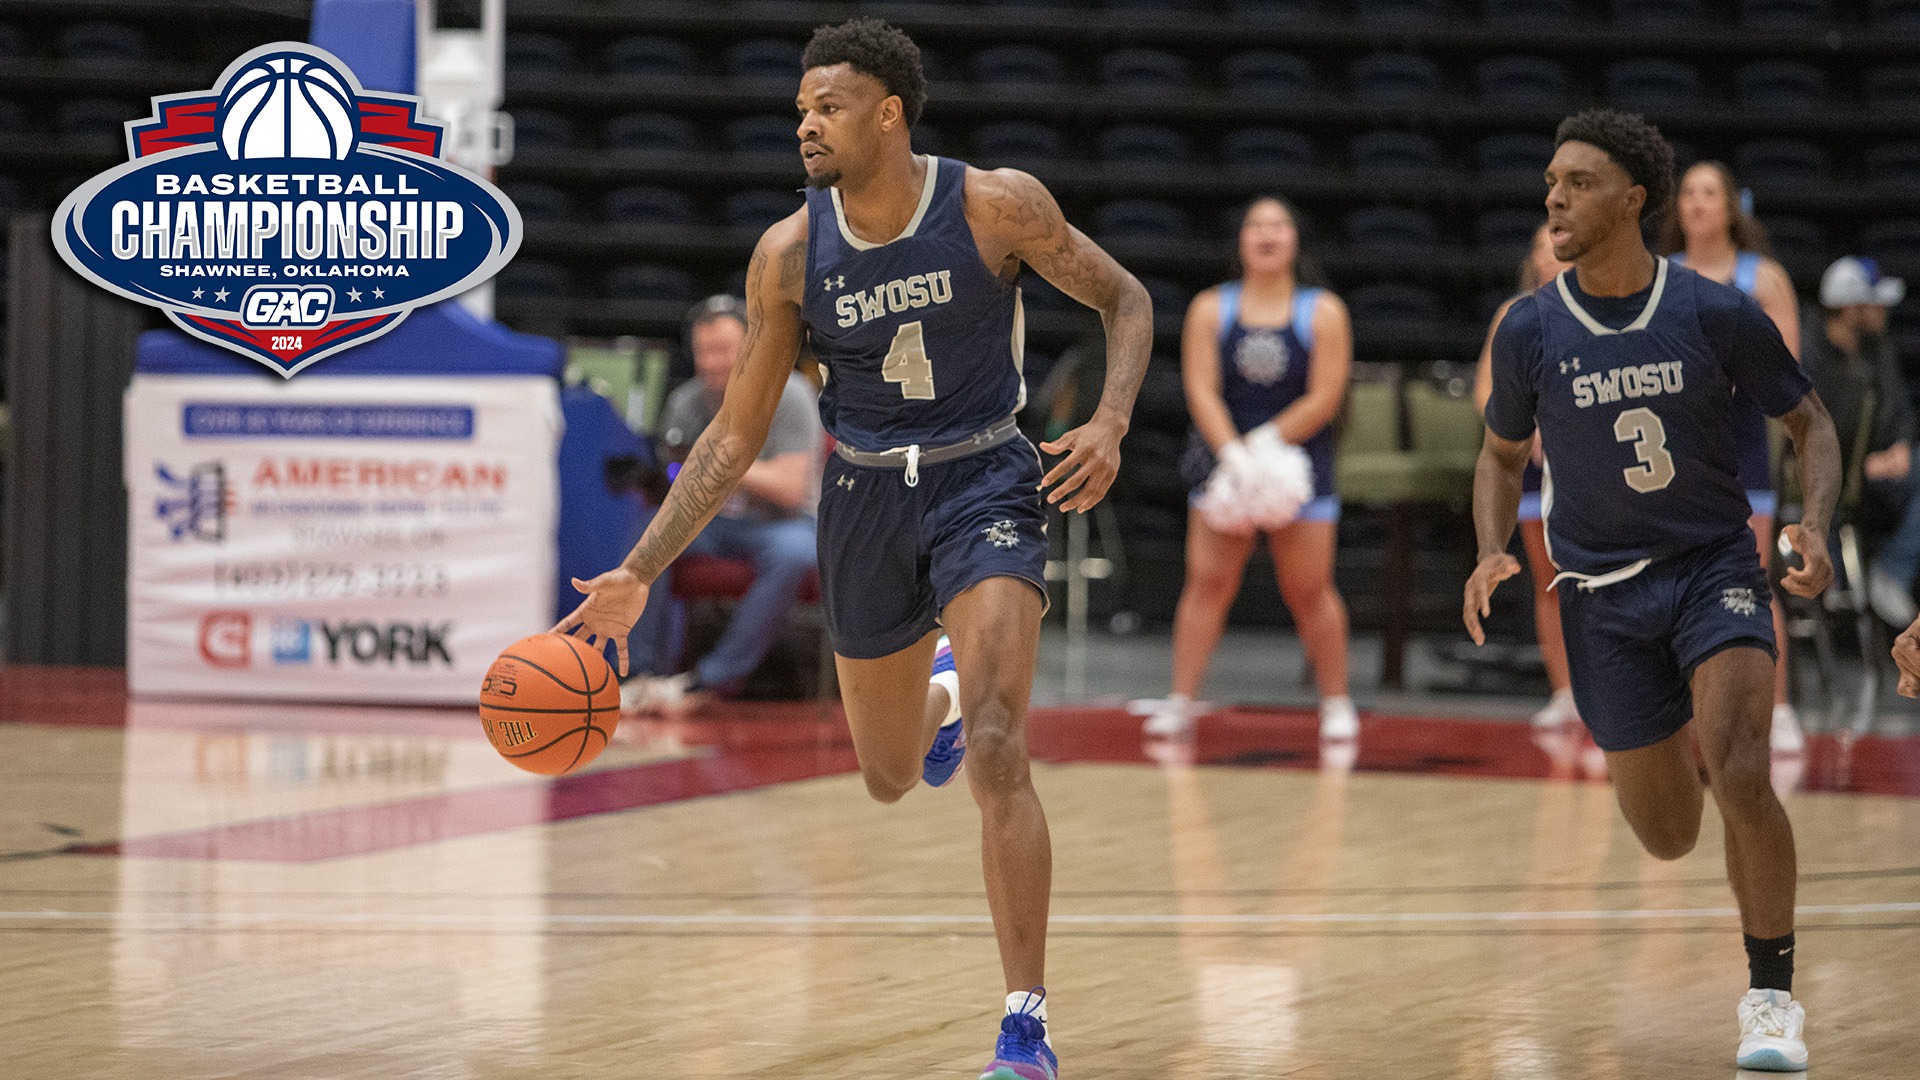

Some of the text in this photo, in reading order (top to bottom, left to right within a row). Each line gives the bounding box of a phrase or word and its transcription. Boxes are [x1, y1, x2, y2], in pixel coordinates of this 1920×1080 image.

[835, 270, 953, 328] SWOSU
[882, 320, 935, 400] 4
[1572, 361, 1684, 408] SWOSU
[1613, 406, 1676, 494] 3
[252, 458, 507, 491] AMERICAN
[319, 618, 455, 666] YORK
[499, 719, 538, 747] THE
